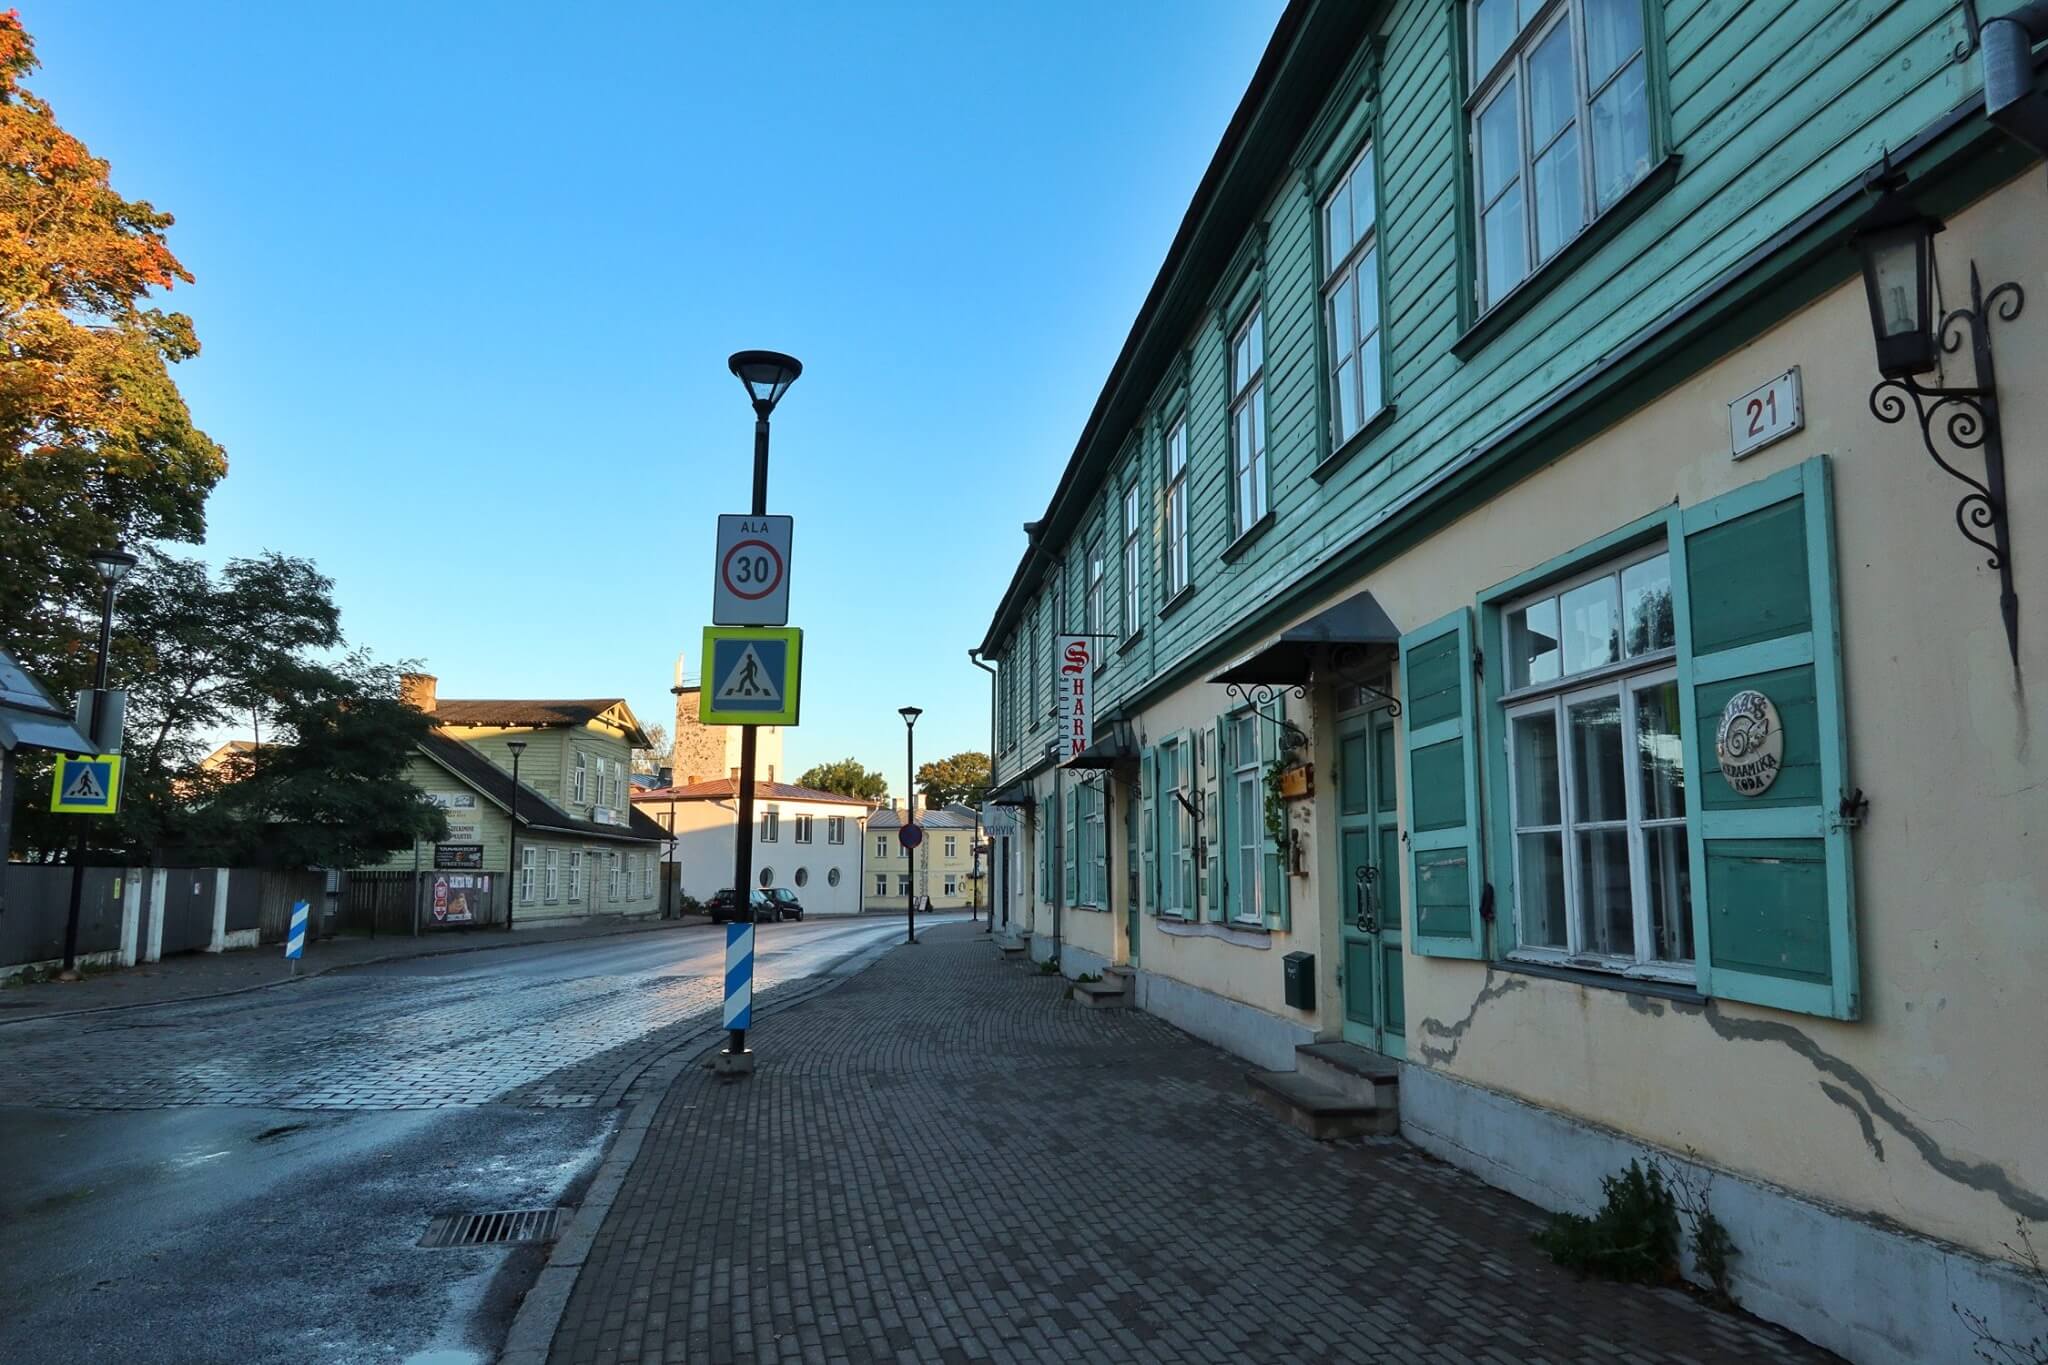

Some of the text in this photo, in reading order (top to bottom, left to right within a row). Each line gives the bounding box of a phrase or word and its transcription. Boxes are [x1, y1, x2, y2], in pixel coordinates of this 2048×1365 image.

[1746, 389, 1777, 439] 21
[740, 520, 769, 533] ALA
[735, 555, 769, 584] 30
[1059, 676, 1070, 757] ILUSALONG
[1061, 640, 1090, 756] SHARM
[1734, 775, 1766, 793] KODA
